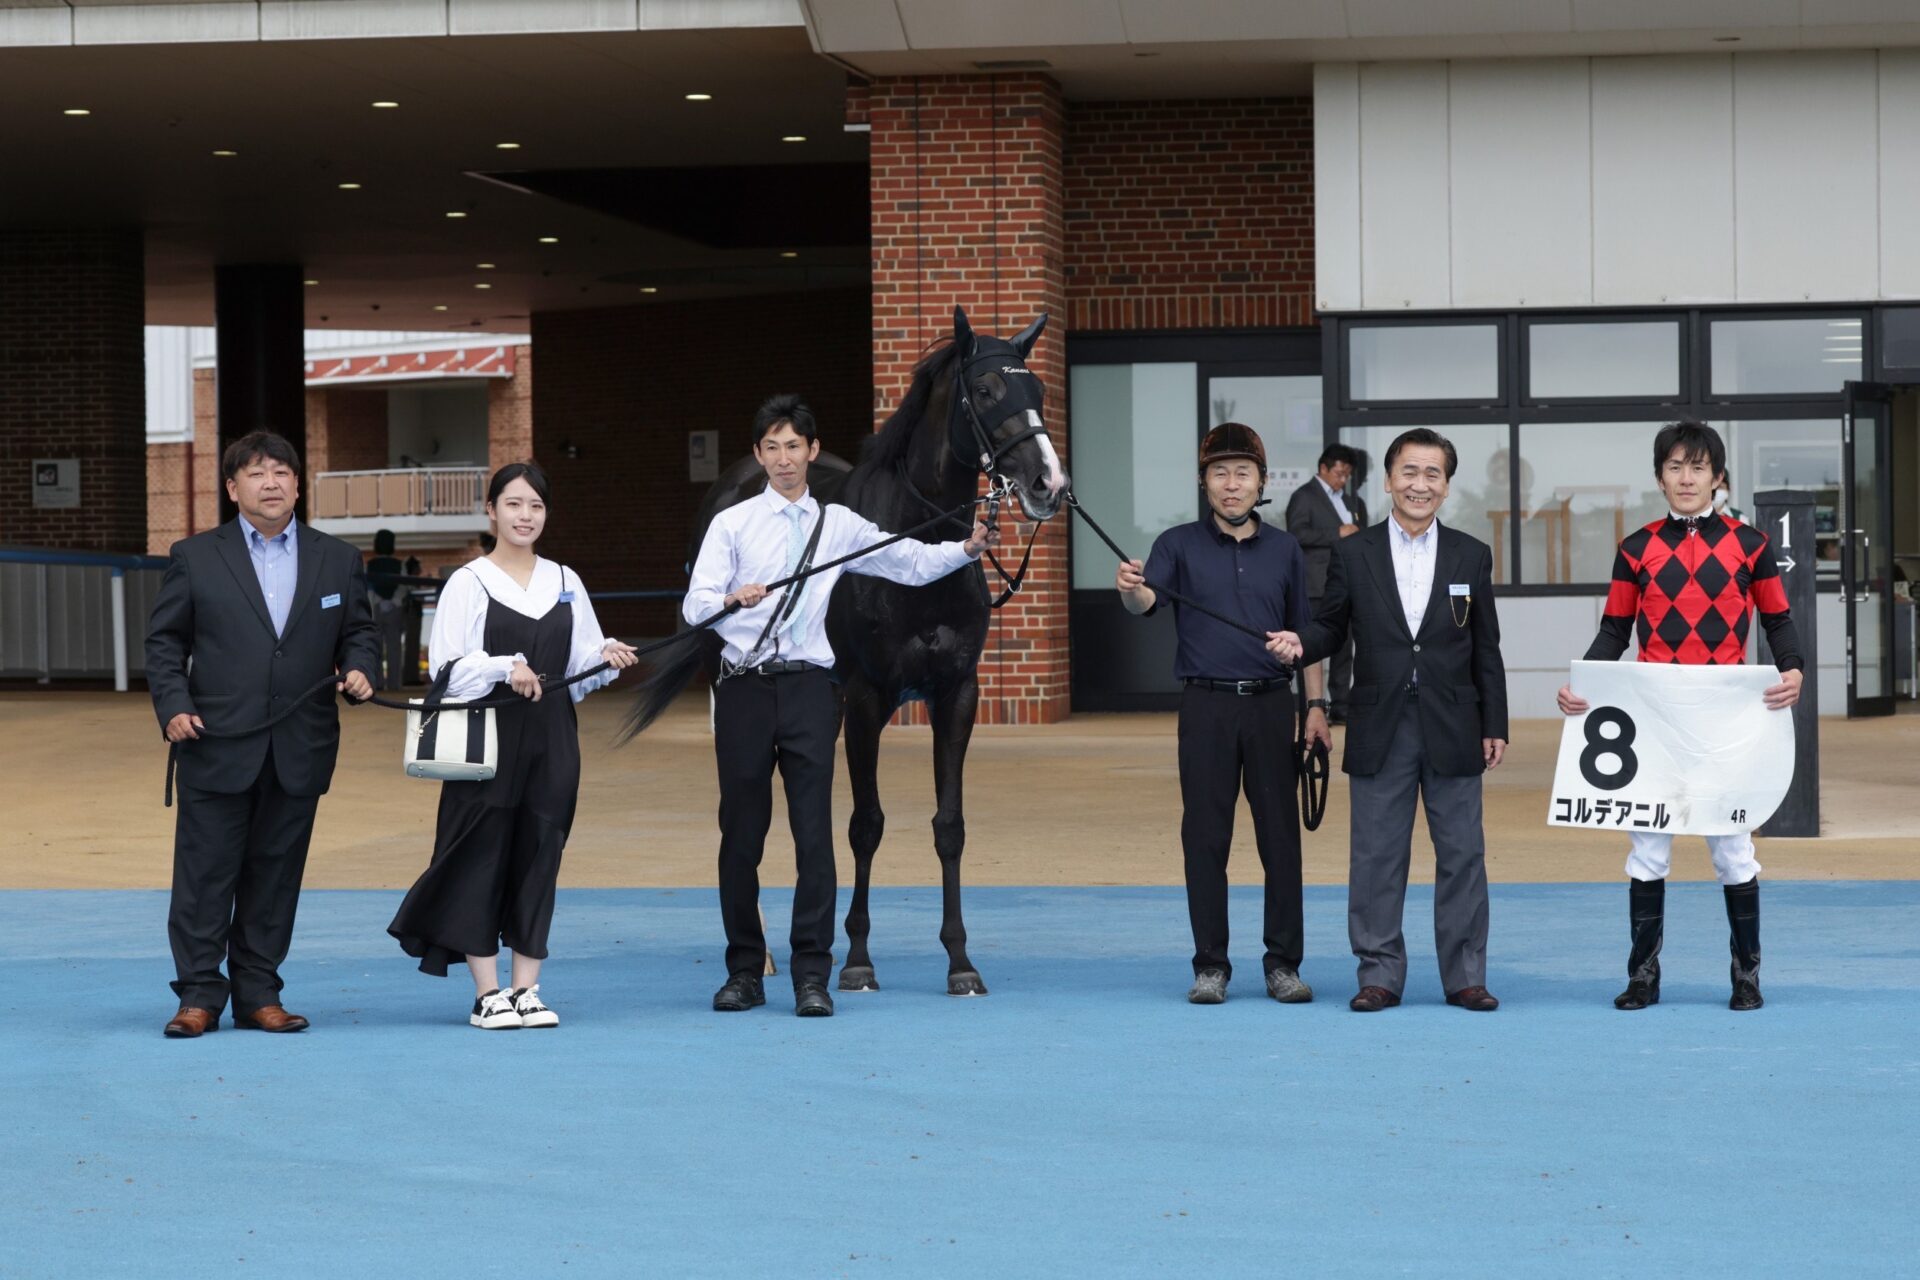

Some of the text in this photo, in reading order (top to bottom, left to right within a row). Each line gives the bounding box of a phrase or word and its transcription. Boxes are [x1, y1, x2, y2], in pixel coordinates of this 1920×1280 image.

[1778, 511, 1791, 548] 1
[1579, 706, 1638, 791] 8
[1555, 798, 1670, 829] コルデアニル
[1731, 809, 1746, 824] 4R
